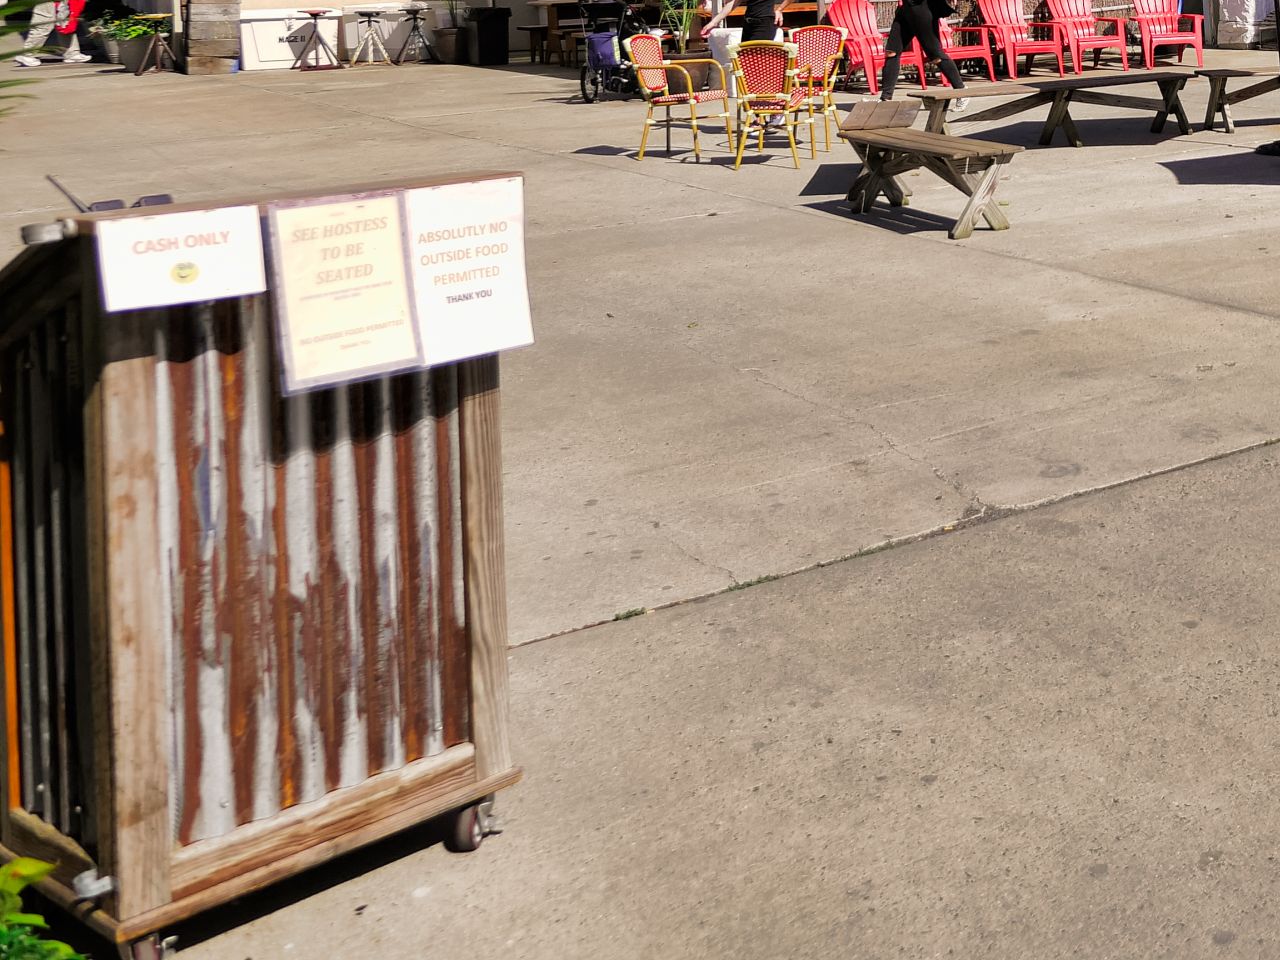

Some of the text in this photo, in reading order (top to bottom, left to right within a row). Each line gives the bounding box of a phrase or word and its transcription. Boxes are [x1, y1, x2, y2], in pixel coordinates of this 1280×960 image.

[291, 216, 389, 243] SEE HOSTESS
[418, 220, 508, 245] ABSOLUTLY NO
[132, 230, 230, 255] CASH ONLY
[320, 242, 365, 261] TO BE
[420, 242, 509, 266] OUTSIDE FOOD
[315, 263, 374, 285] SEATED
[433, 265, 501, 286] PERMITTED
[445, 289, 493, 304] THANK YOU
